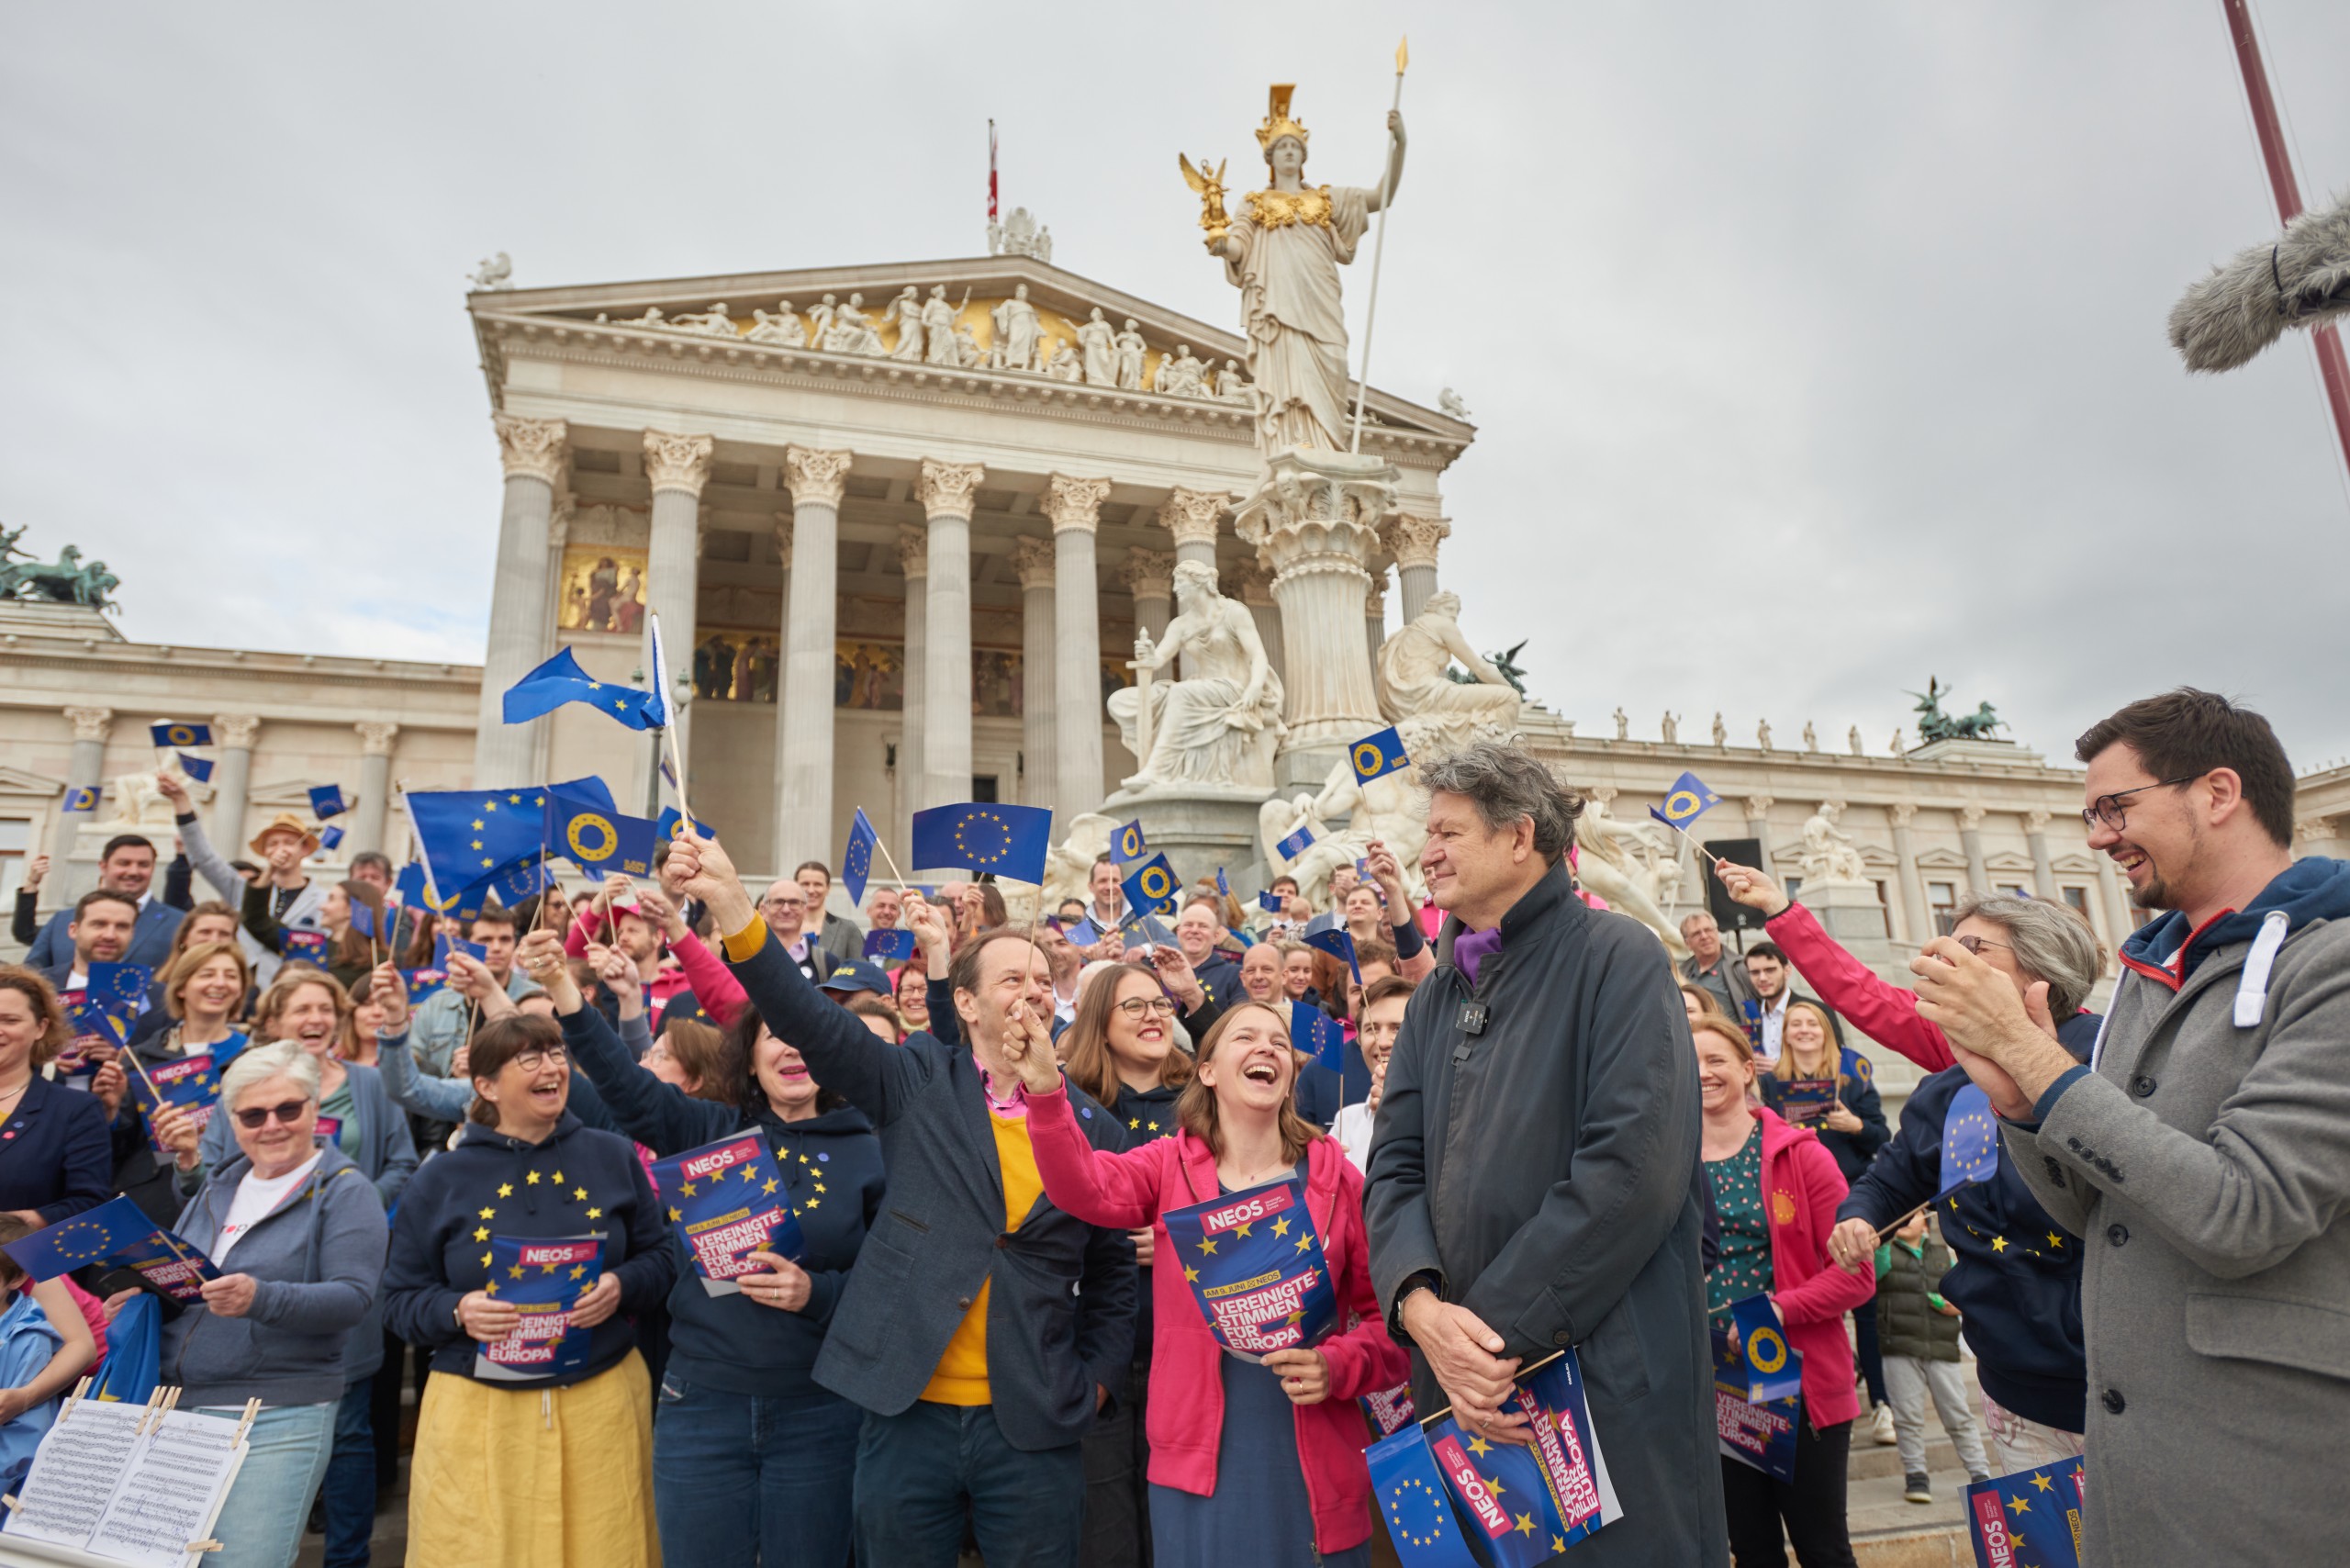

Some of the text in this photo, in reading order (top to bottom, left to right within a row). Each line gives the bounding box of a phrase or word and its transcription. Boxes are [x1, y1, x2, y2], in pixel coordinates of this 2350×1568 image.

[55, 995, 71, 1006] OS
[651, 996, 668, 1009] NE
[156, 1063, 192, 1081] NEOS
[688, 1150, 734, 1176] NEOS
[1208, 1200, 1263, 1230] NEOS
[693, 1211, 781, 1248] VEREINIGTE
[526, 1248, 573, 1262] NEOS
[699, 1230, 768, 1259] STIMMEN
[140, 1259, 202, 1279] REINIGTE
[150, 1271, 193, 1285] MMEN
[170, 1286, 199, 1298] OPA
[1212, 1272, 1315, 1316] VEREINIGTE
[1228, 1283, 1246, 1294] JUNI
[1257, 1271, 1280, 1285] NEOS
[518, 1314, 572, 1327] REINIGT
[1217, 1295, 1301, 1327] STIMMEN
[510, 1326, 564, 1339] IMMEN
[1223, 1325, 1259, 1338] FÜR
[1229, 1327, 1301, 1350] EUROPA
[489, 1348, 553, 1361] EUROPA
[1382, 1400, 1415, 1434] EUROPA
[1717, 1392, 1786, 1431] VEREINIGTE
[1718, 1403, 1772, 1435] STIMMEN
[1521, 1394, 1575, 1524] VEREINIGTE
[1528, 1441, 1544, 1466] NEOS
[1544, 1414, 1583, 1518] STIMMEN
[1561, 1414, 1598, 1510] EUROPA
[1456, 1468, 1505, 1529] NEOS
[1548, 1479, 1558, 1502] JUNI
[1568, 1467, 1590, 1515] FÜR
[2068, 1510, 2081, 1532] NEOS
[1985, 1520, 2012, 1568] NEOS
